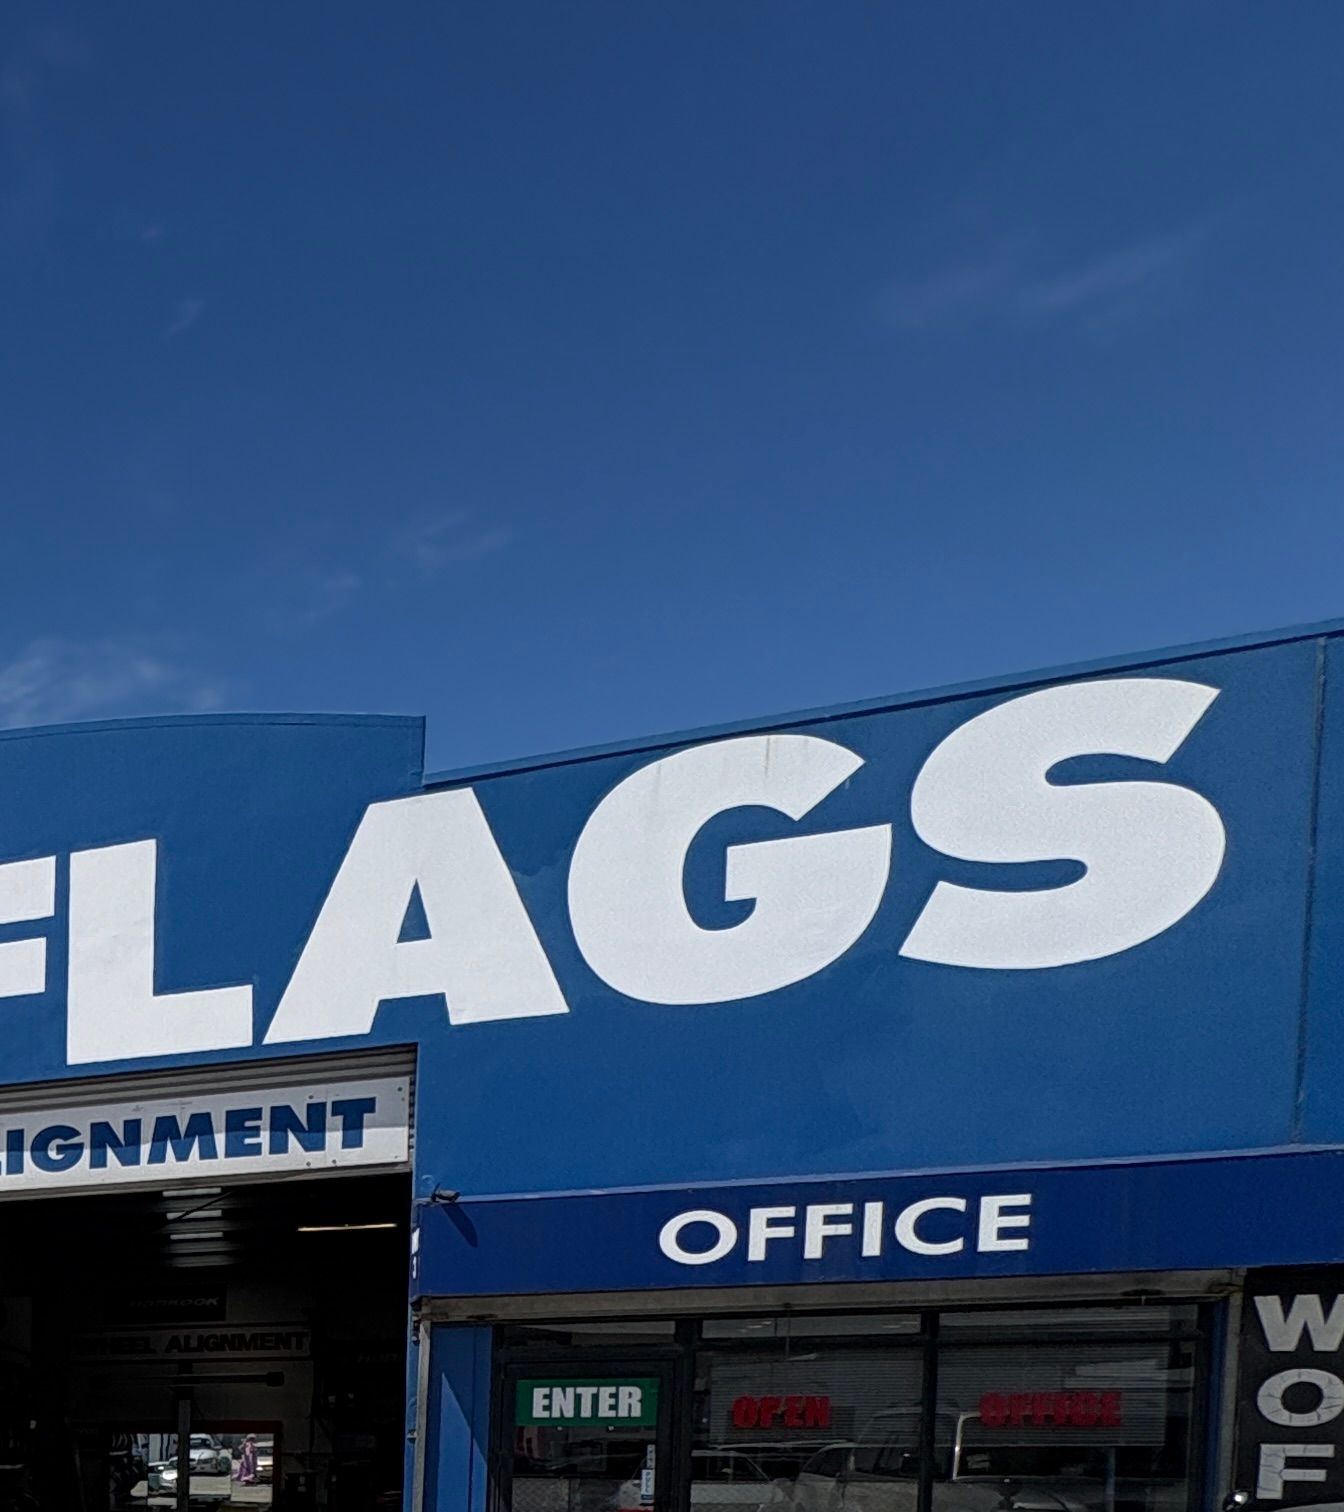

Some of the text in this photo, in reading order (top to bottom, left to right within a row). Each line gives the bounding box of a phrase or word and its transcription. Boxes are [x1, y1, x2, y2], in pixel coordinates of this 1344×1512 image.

[658, 1192, 1033, 1266] OFFICE
[165, 1331, 310, 1354] ALIGNMENT
[531, 1385, 644, 1420] ENTER
[732, 1395, 832, 1431] OPEN
[1253, 1293, 1344, 1500] WOF
